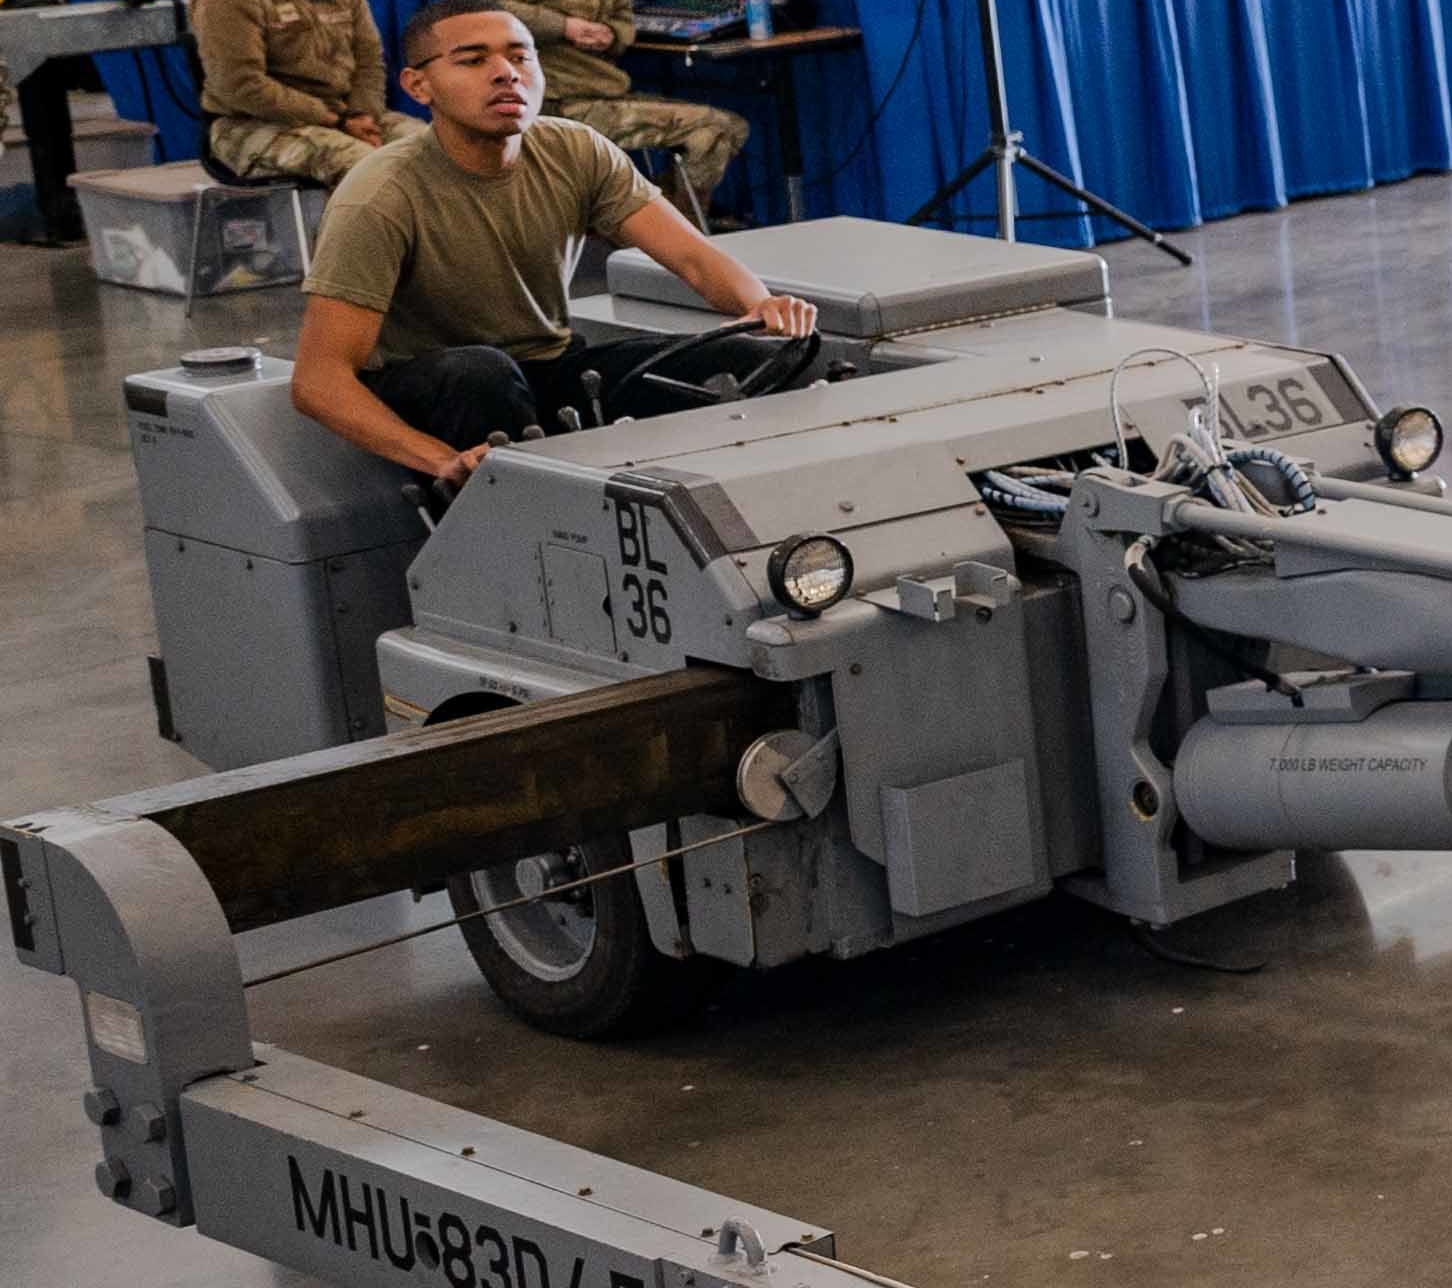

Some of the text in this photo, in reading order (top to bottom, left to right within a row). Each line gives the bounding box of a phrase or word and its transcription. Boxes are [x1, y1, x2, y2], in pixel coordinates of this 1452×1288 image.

[615, 500, 668, 576] BL
[622, 573, 672, 645] 36
[1318, 757, 1367, 773] WEIGHT
[1367, 757, 1428, 773] CAPACITY
